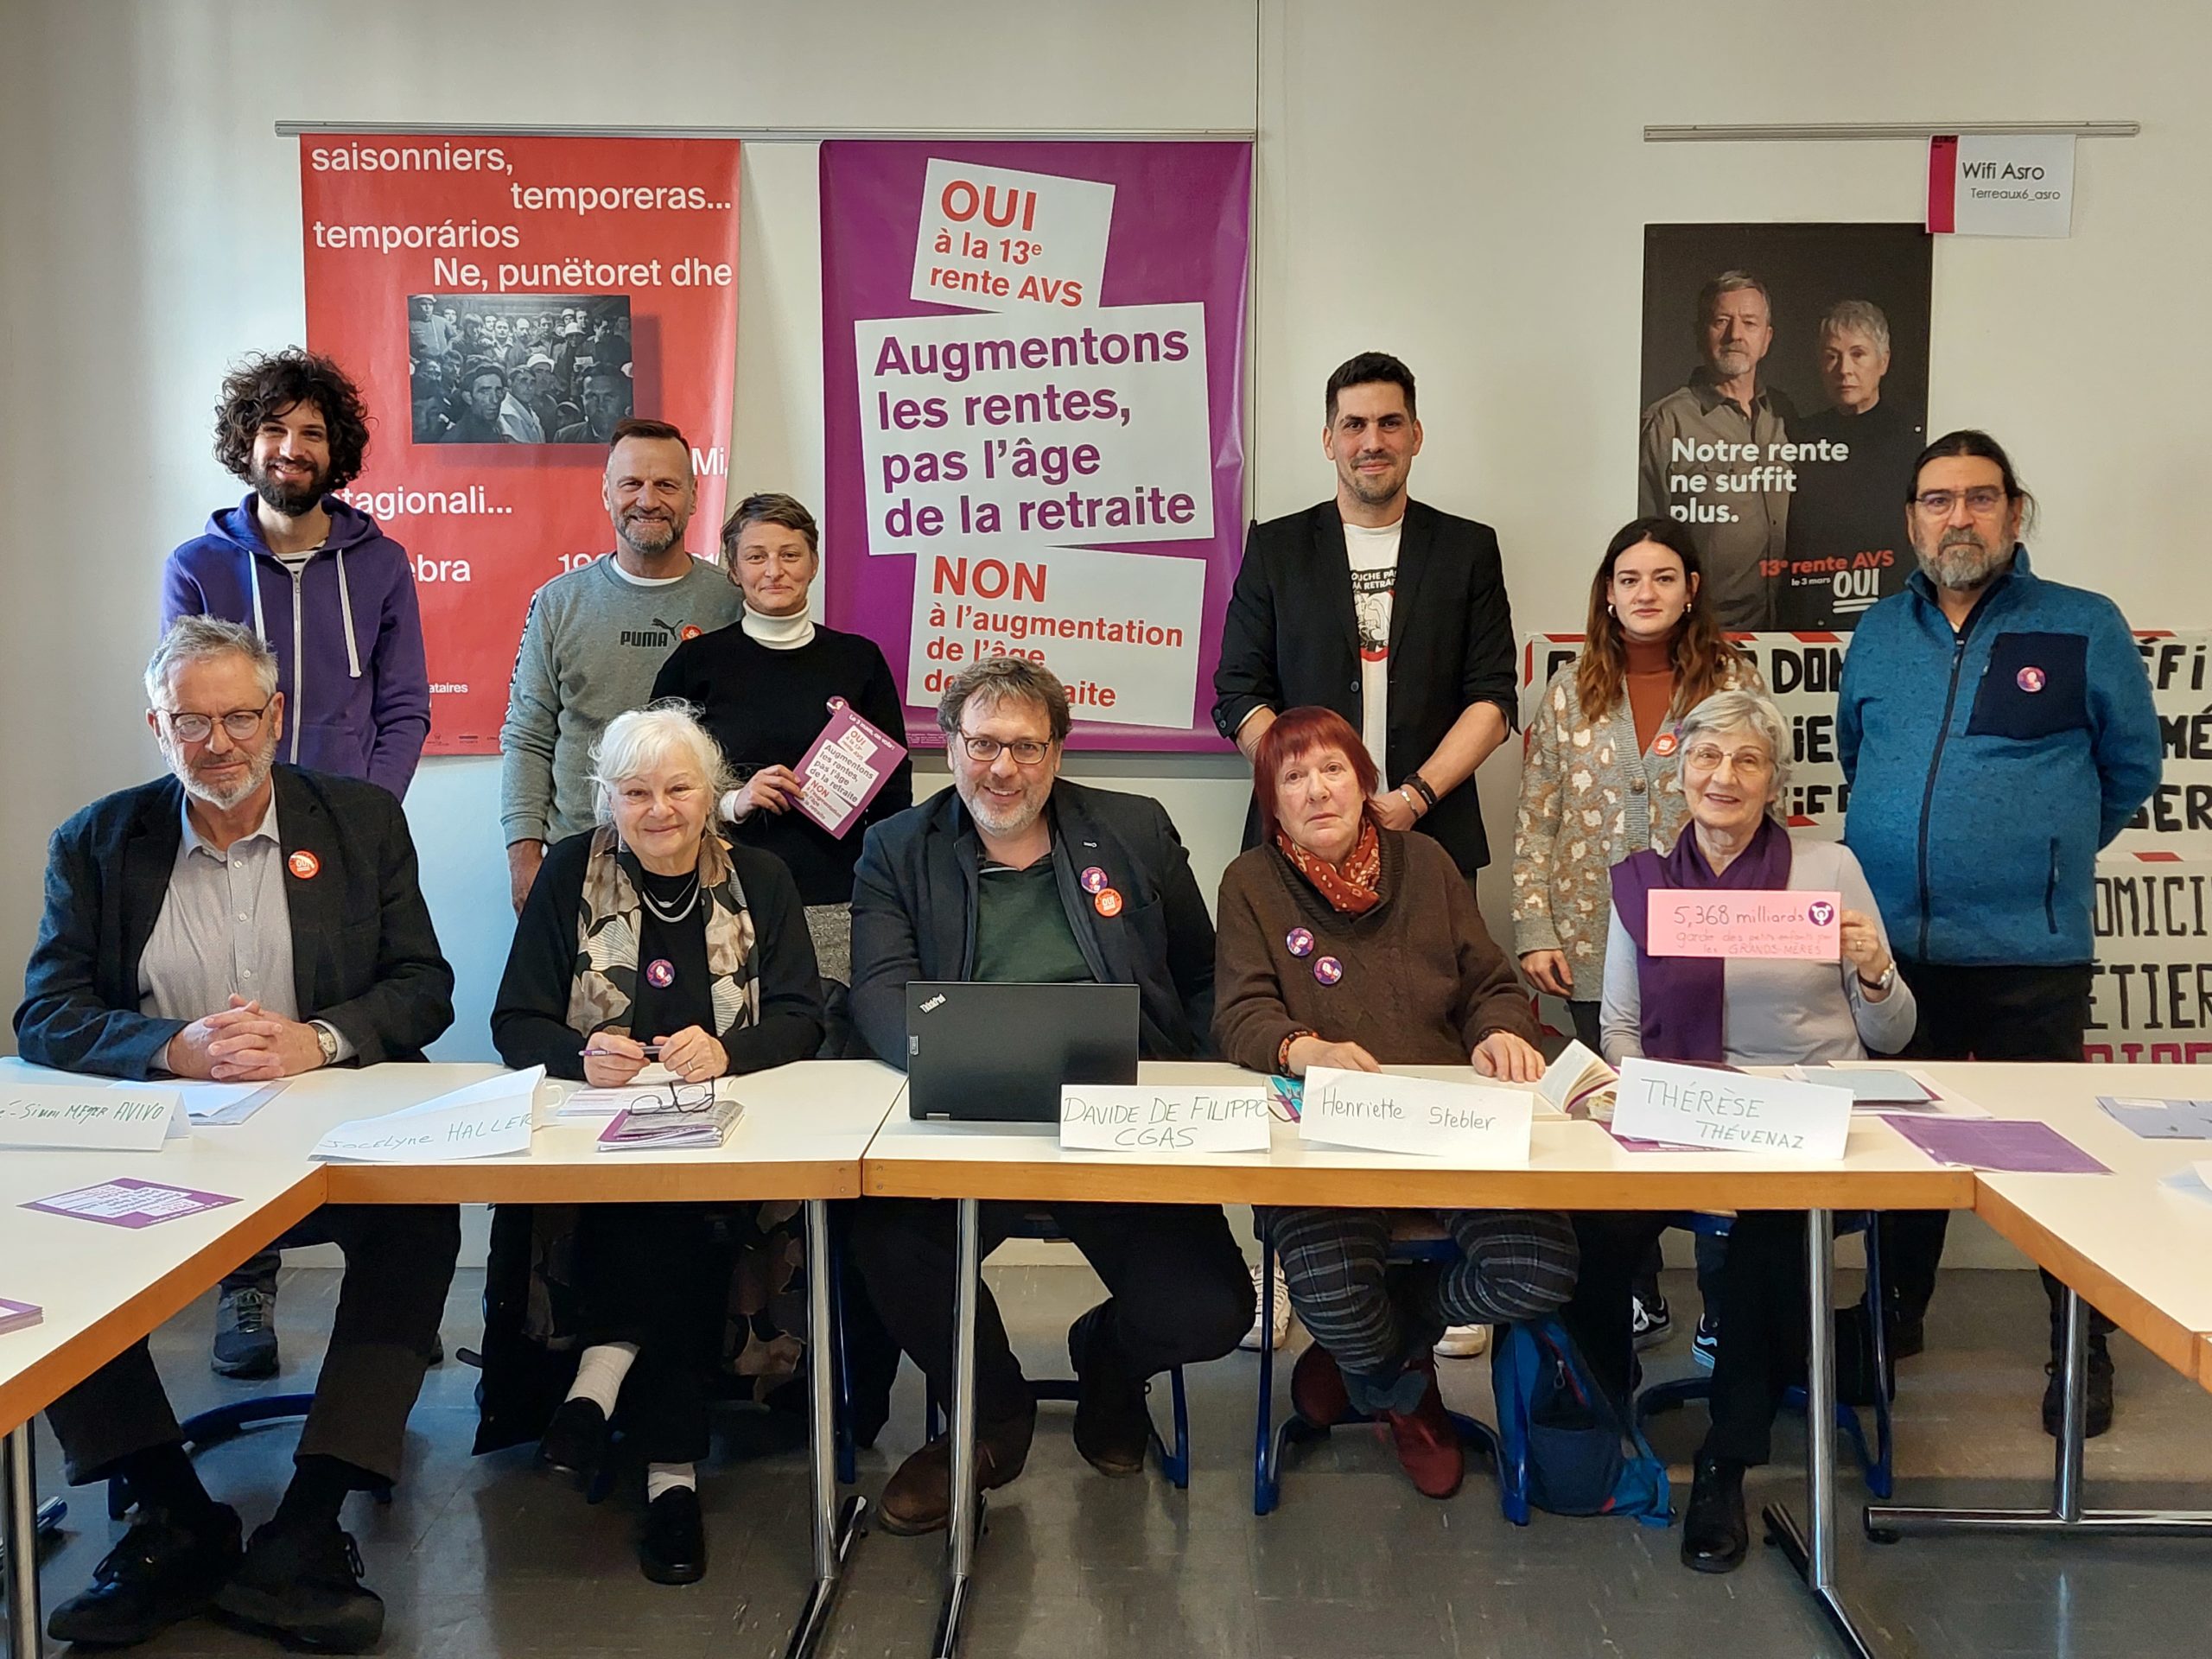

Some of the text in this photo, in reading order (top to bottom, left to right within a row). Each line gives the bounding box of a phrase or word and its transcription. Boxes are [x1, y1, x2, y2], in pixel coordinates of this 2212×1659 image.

[311, 142, 514, 176] saisonniers,
[1962, 162, 2045, 181] Wifi Asro
[511, 181, 732, 215] temporeras...
[941, 179, 1038, 232] OUI
[1970, 187, 2061, 201] Terreaux6_asro
[313, 219, 520, 254] temporários
[934, 227, 952, 255] à
[962, 230, 988, 260] la
[433, 257, 733, 291] Ne, punëtoret dhe
[929, 265, 1084, 308] rente AVS
[874, 326, 1189, 383] Augmentons
[878, 384, 1131, 430] les rentes,
[881, 436, 1102, 493] pas l'âge
[1671, 437, 1850, 463] Notre rente
[1669, 466, 1797, 493] ne suffit
[330, 485, 512, 521] tagionali...
[884, 486, 1196, 538] de la retraite
[1669, 497, 1740, 524] plus.
[932, 555, 1047, 602] NON
[1790, 554, 1849, 575] rente
[1852, 550, 1895, 570] AVS
[1790, 575, 1832, 588] le 3 mars
[1833, 568, 1881, 599] OUI
[620, 631, 669, 647] PUMA
[928, 601, 1184, 647] à l'augmentation
[926, 635, 964, 662] de
[850, 730, 867, 747] OUI
[813, 760, 830, 775] pas
[819, 751, 831, 766] les
[824, 744, 874, 779] Augmentons
[809, 767, 859, 804] de la retraite
[810, 779, 830, 798] NON
[1673, 904, 1805, 929] 5,368 milliards
[1063, 1096, 1141, 1125] DAVIDE
[1147, 1096, 1182, 1124] DE
[1320, 1087, 1497, 1132] Henriette Stebler
[1640, 1077, 1765, 1119] THÉRÈSE
[1114, 1127, 1199, 1149] CGAS
[1695, 1120, 1805, 1150] THÉVENAZ
